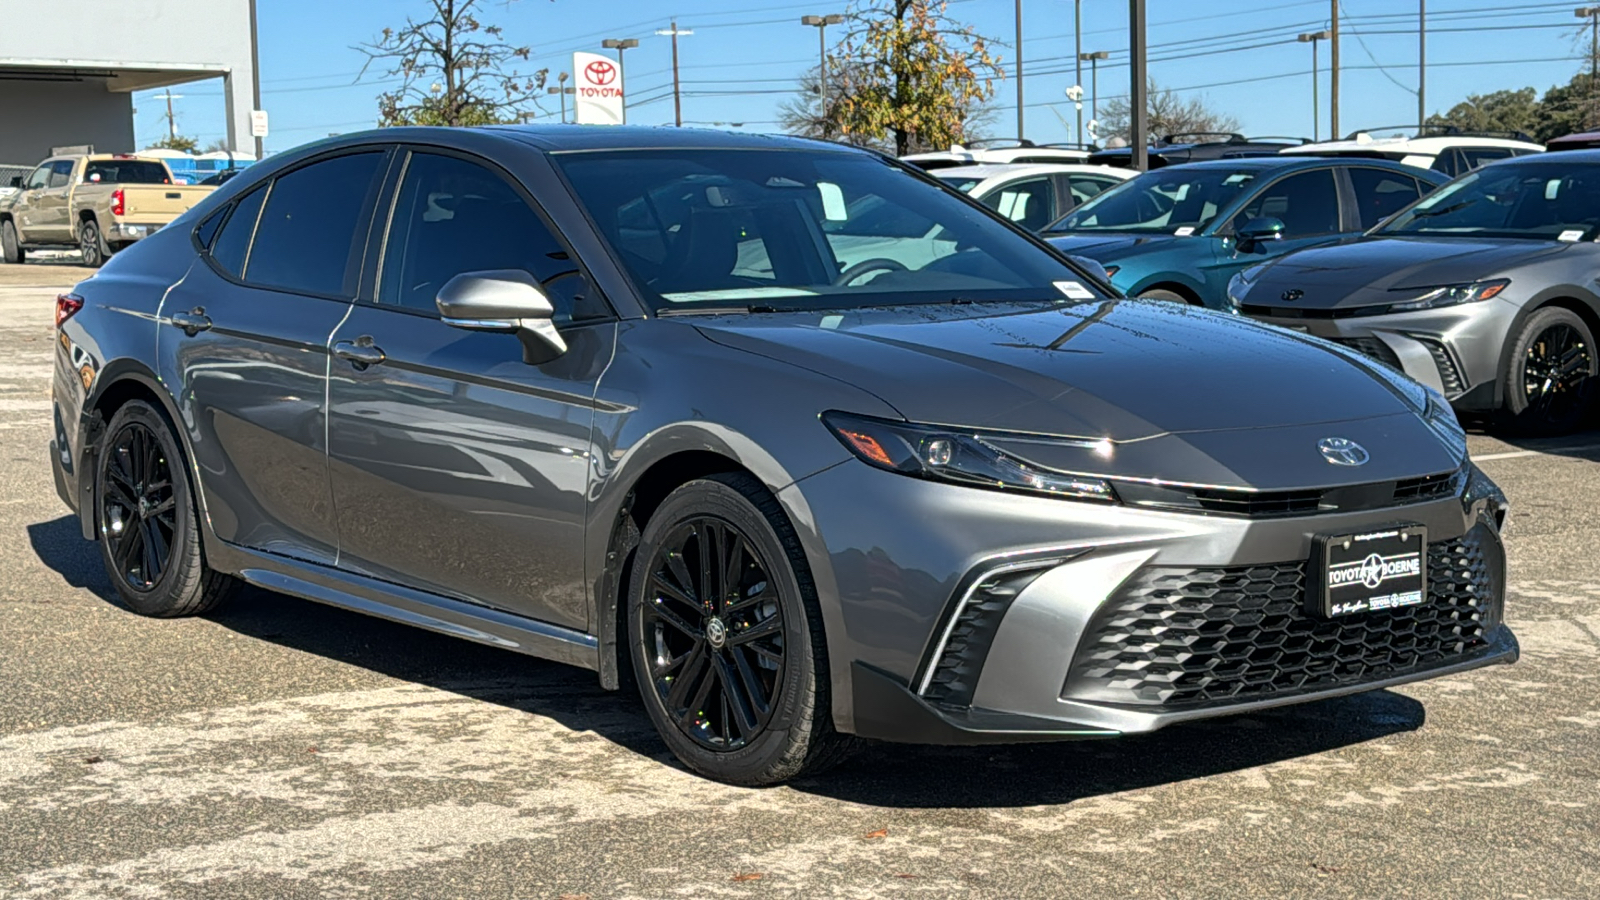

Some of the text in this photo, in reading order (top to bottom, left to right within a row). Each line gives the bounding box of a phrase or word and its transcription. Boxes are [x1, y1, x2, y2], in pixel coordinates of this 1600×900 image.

[579, 87, 623, 98] TOYOTA
[1329, 558, 1420, 584] TOYOTA BOERNE
